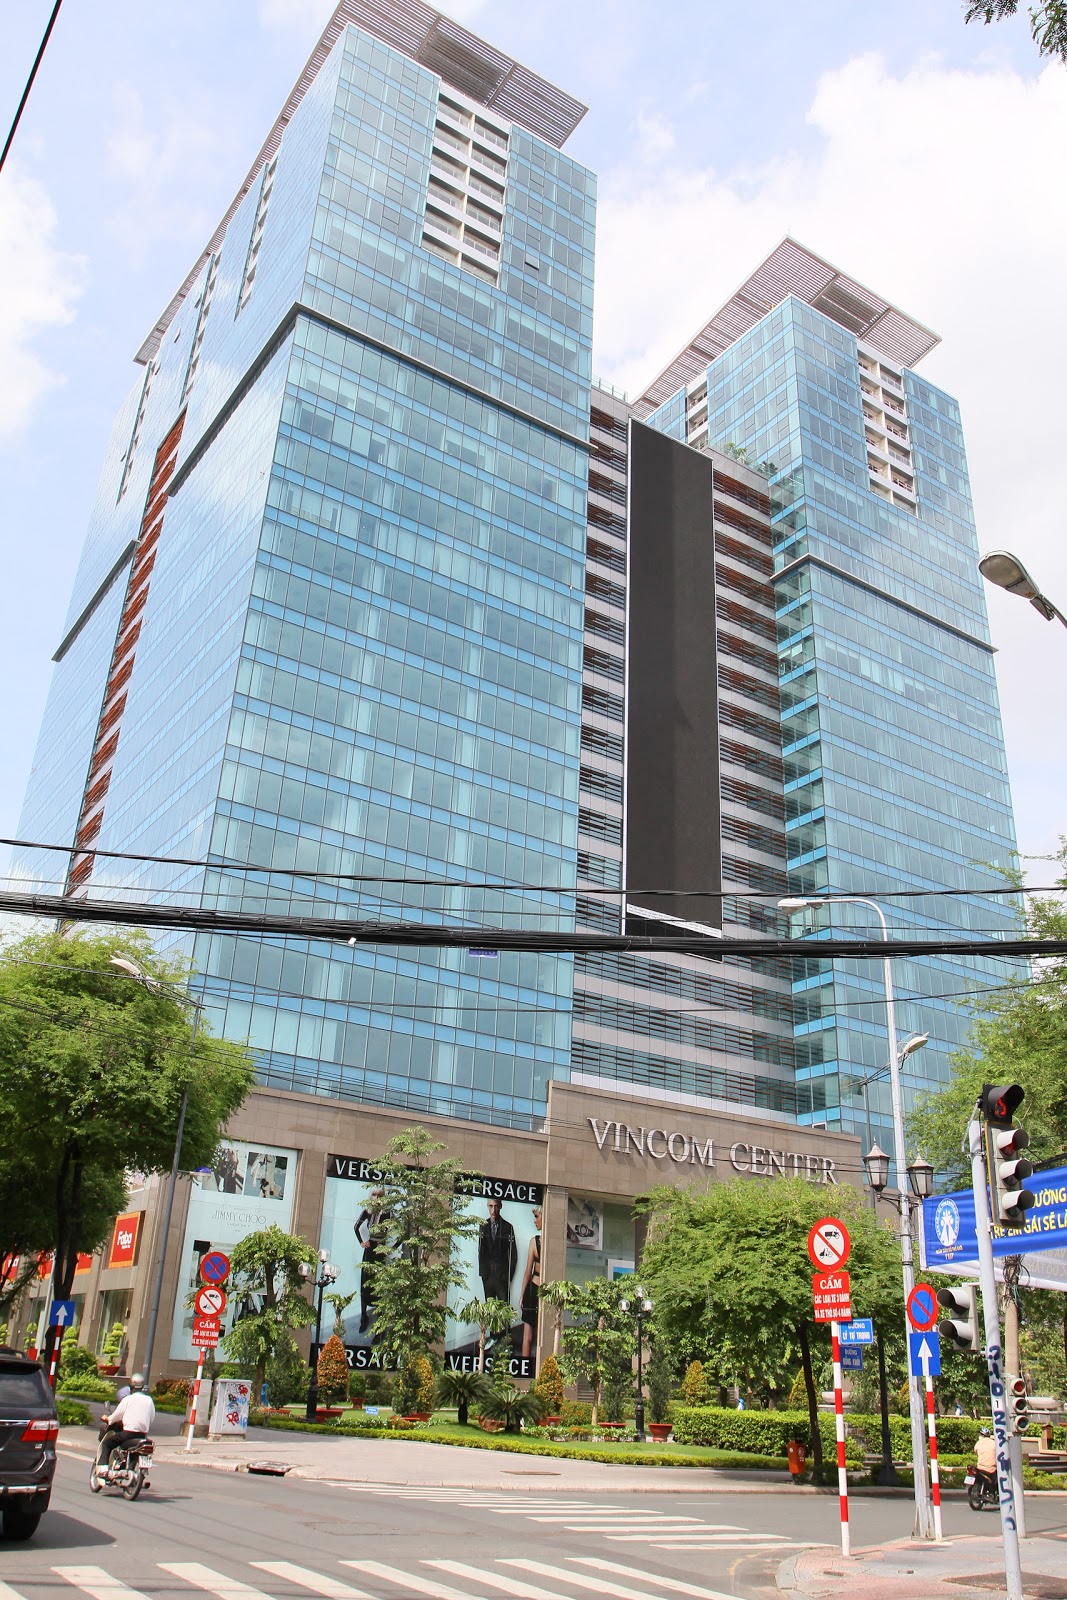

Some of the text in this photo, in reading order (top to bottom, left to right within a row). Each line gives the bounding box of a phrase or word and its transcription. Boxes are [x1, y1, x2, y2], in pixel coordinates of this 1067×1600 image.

[587, 1117, 838, 1185] VINCOM CENTER
[1032, 1187, 1067, 1209] ƯỜNG
[212, 1210, 266, 1224] JIMMY CHOO
[1024, 1215, 1042, 1234] GÁI
[1043, 1211, 1056, 1231] SẼ
[820, 1274, 843, 1290] CẤM
[199, 1319, 216, 1329] CẤM
[449, 1355, 530, 1376] VERSCE
